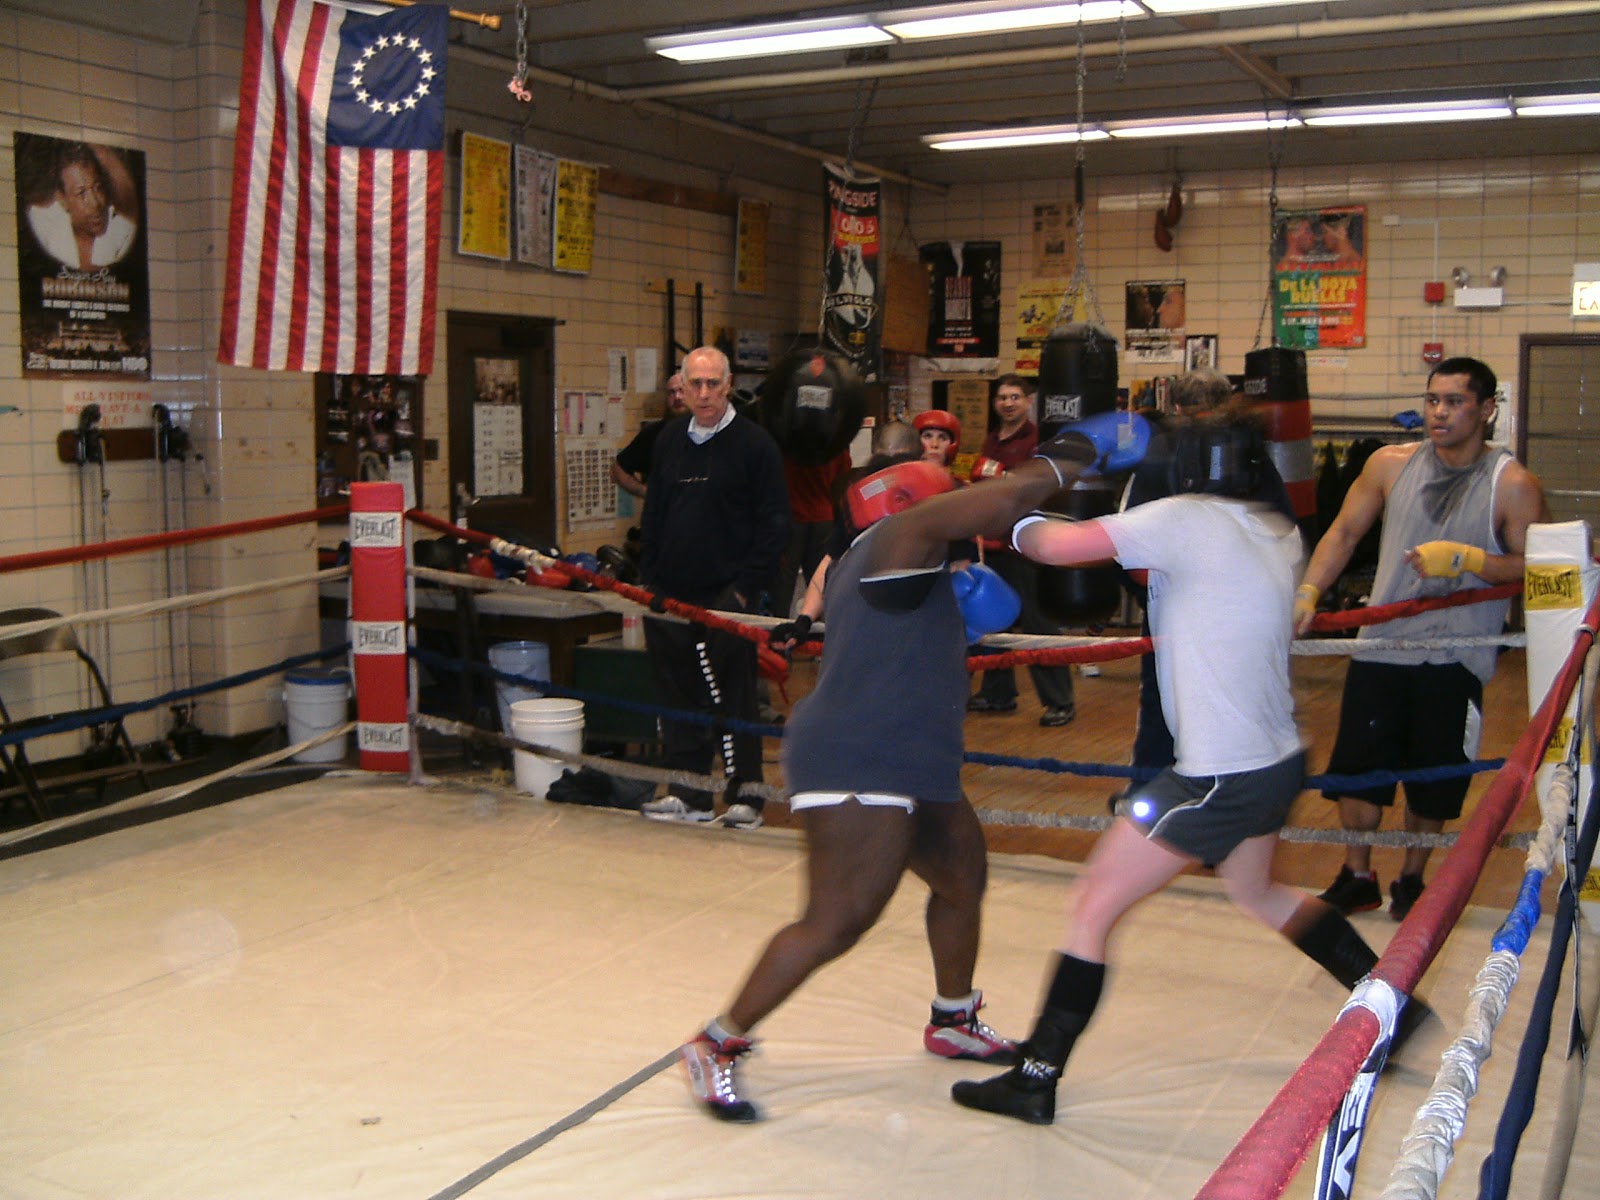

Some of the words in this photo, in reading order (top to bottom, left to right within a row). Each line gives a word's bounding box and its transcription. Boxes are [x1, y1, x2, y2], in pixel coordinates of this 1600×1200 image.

[354, 517, 397, 540] EVERLAST
[1527, 570, 1573, 600] EVERLAST
[358, 626, 399, 648] EVERLAST
[363, 727, 404, 746] EVERLAST
